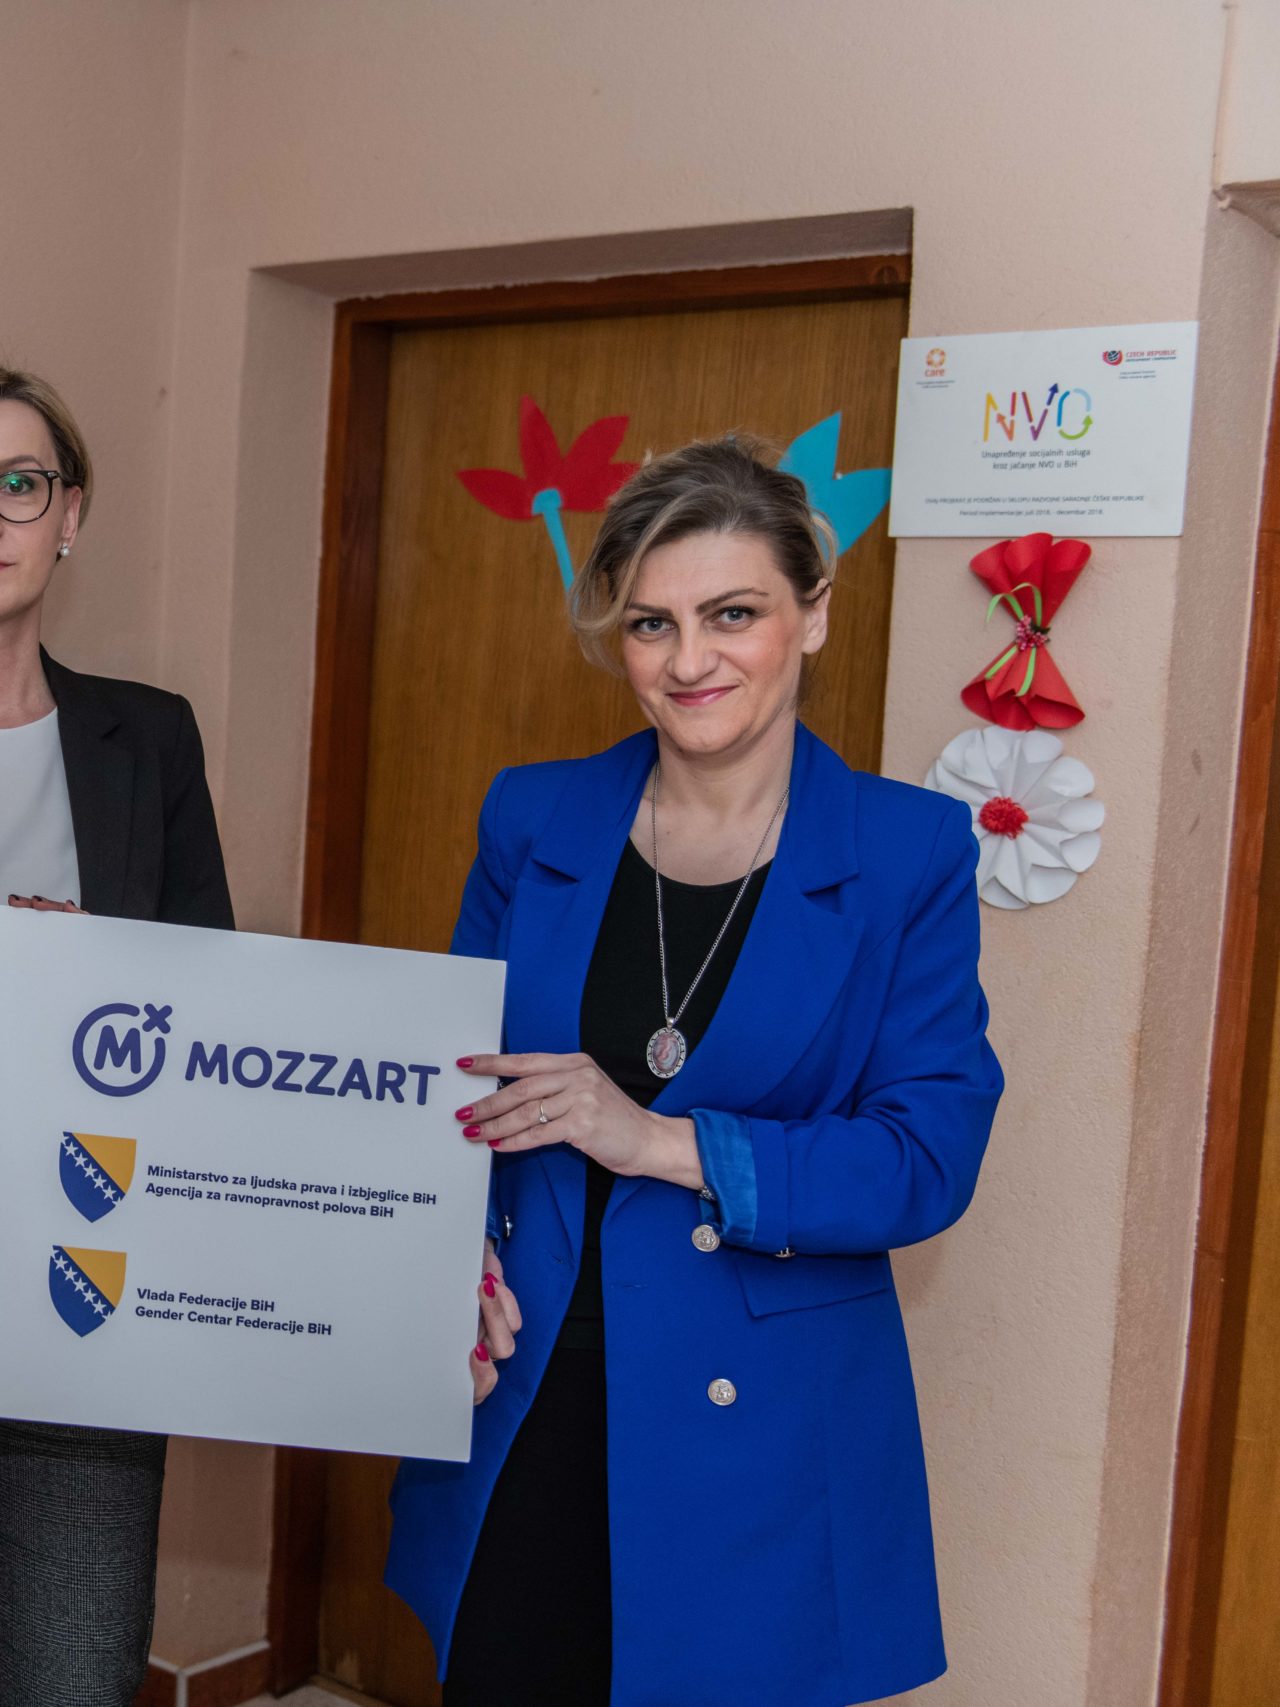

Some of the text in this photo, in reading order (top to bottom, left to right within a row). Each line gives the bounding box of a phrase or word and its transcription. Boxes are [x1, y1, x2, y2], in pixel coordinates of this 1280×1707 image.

[924, 368, 946, 378] care
[982, 383, 1093, 442] NVO
[981, 447, 1091, 459] Unapređenje socijalnih usluga
[992, 461, 1008, 469] kroz
[1038, 460, 1055, 469] NVO
[184, 1040, 441, 1106] MOZZART
[145, 1182, 394, 1218] Agencija za ravnopravnost polova BiH
[147, 1165, 437, 1205] Ministarstvo za ljudska prava i izbjeglice BiH
[136, 1288, 275, 1312] Vlada Federacije BiH
[135, 1306, 332, 1336] Gender Centar Federacije BiH
